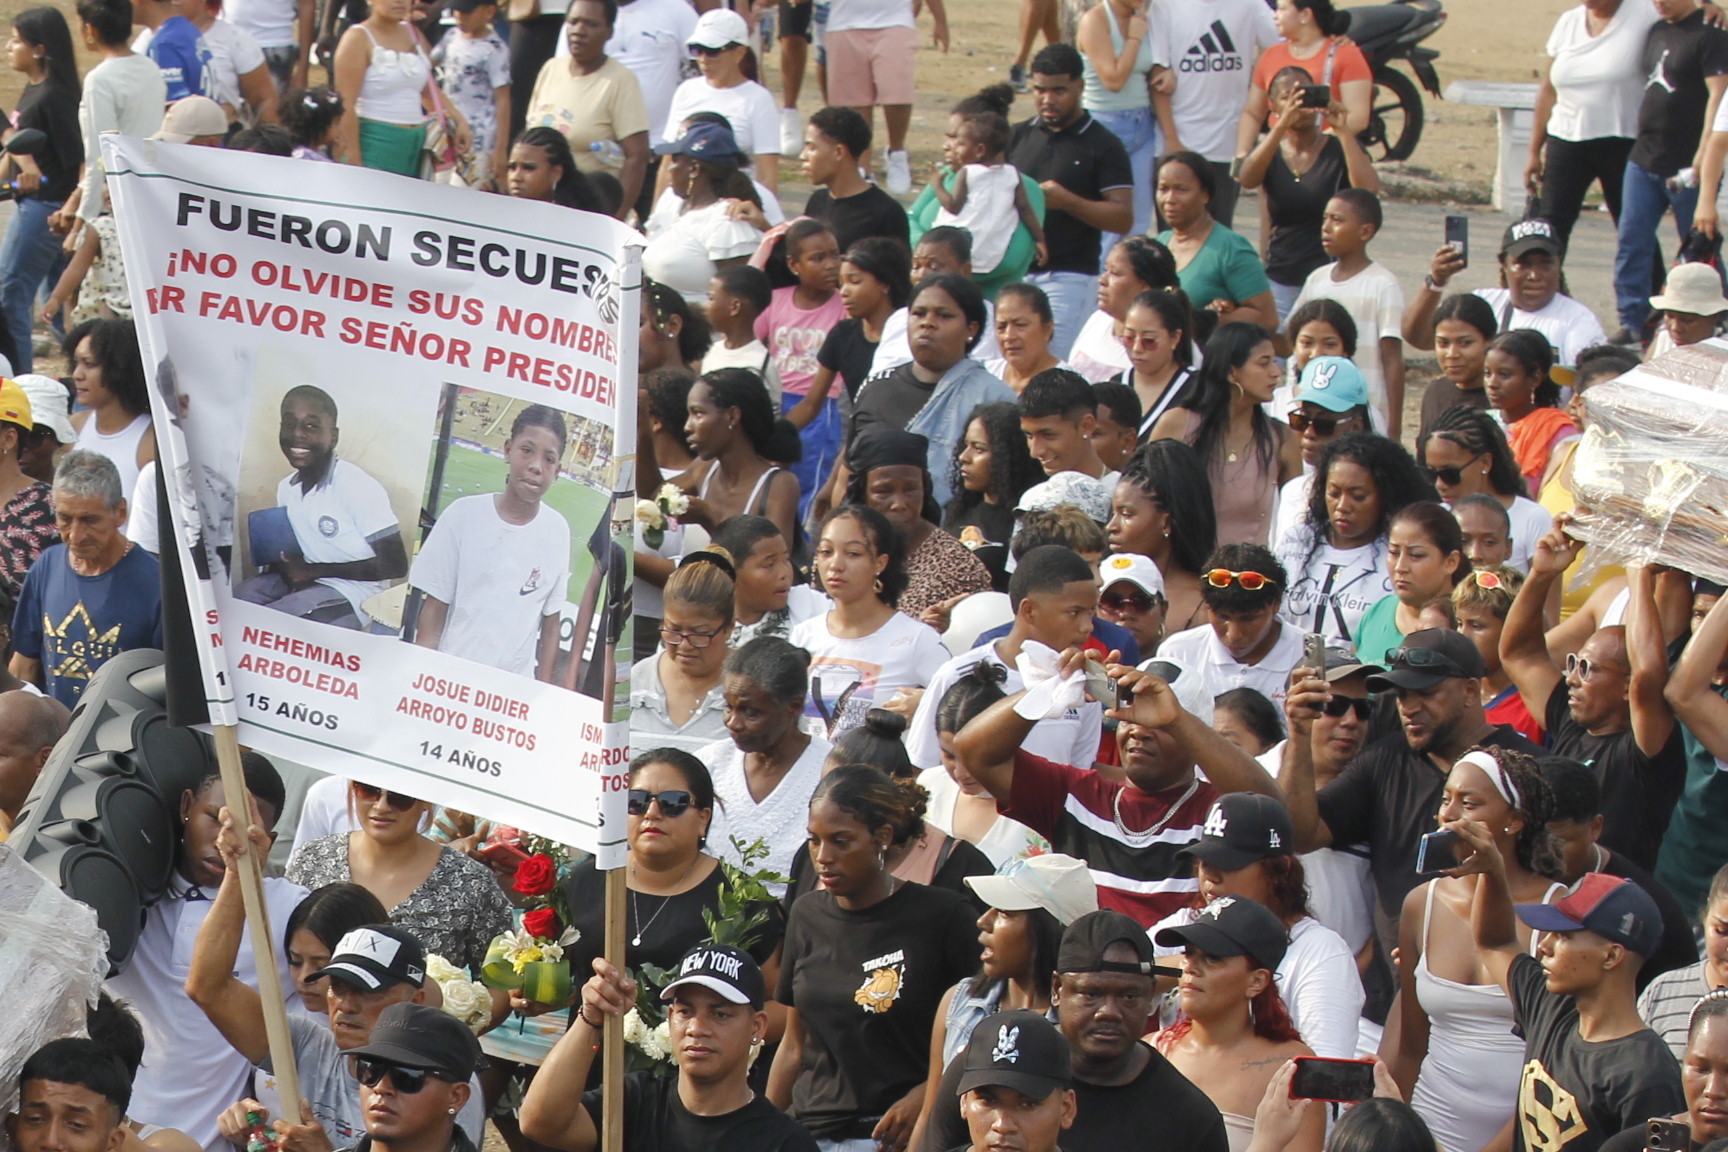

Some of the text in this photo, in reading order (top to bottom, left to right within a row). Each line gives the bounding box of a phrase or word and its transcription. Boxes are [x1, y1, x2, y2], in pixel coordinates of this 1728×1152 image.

[1179, 53, 1244, 73] adidas
[175, 191, 392, 262] FUERON
[166, 248, 238, 279] ¡NO
[250, 259, 393, 309] OLVIDE
[406, 289, 484, 326] SUS
[198, 290, 324, 338] FAVOR
[338, 310, 470, 367] SEÑOR
[241, 626, 362, 673] NEHEMIAS
[236, 653, 360, 701] ARBOLEDA
[411, 673, 531, 721] JOSUE DIDIER
[245, 692, 339, 731] 15 AÑOS
[395, 696, 537, 752] ARROYO BUSTOS
[418, 741, 503, 778] 14 AÑOS
[1269, 828, 1281, 848] LA
[680, 950, 744, 980] NEW YORK
